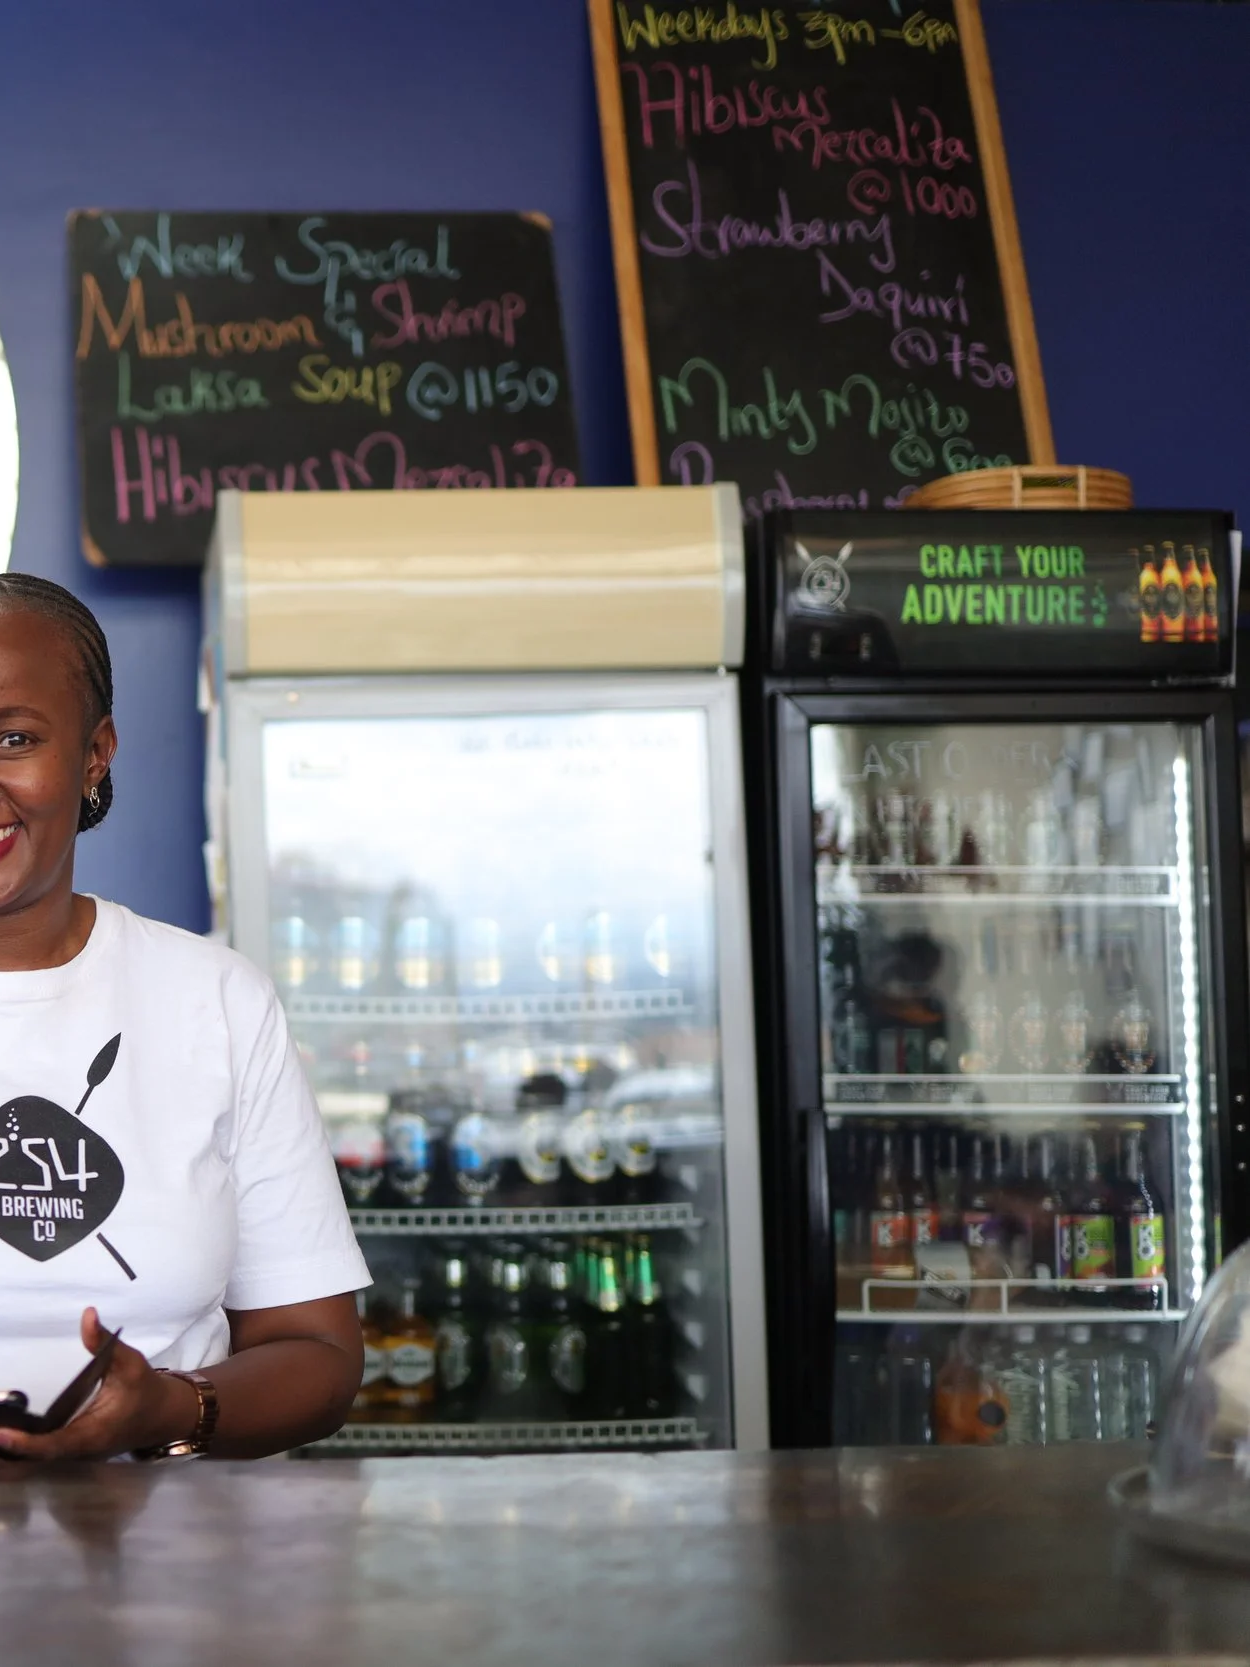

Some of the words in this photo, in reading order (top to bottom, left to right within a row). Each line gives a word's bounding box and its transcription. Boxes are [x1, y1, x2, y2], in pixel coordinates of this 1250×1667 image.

[616, 0, 789, 71] Weekdays
[621, 62, 831, 148] Hibiscus
[640, 155, 896, 273] Strawberry
[846, 168, 978, 219] @1000
[102, 213, 253, 283] Week
[275, 217, 461, 310] Special
[76, 273, 321, 359] Mushroom
[371, 280, 526, 348] Shrimp
[117, 351, 269, 421] Laksa
[291, 354, 403, 416] Soup
[406, 360, 559, 421] @1150
[658, 357, 817, 455] Minty
[919, 543, 1005, 579] CRAFT
[1015, 544, 1086, 578] YOUR
[844, 740, 932, 781] AST
[1, 1195, 84, 1220] BREWING
